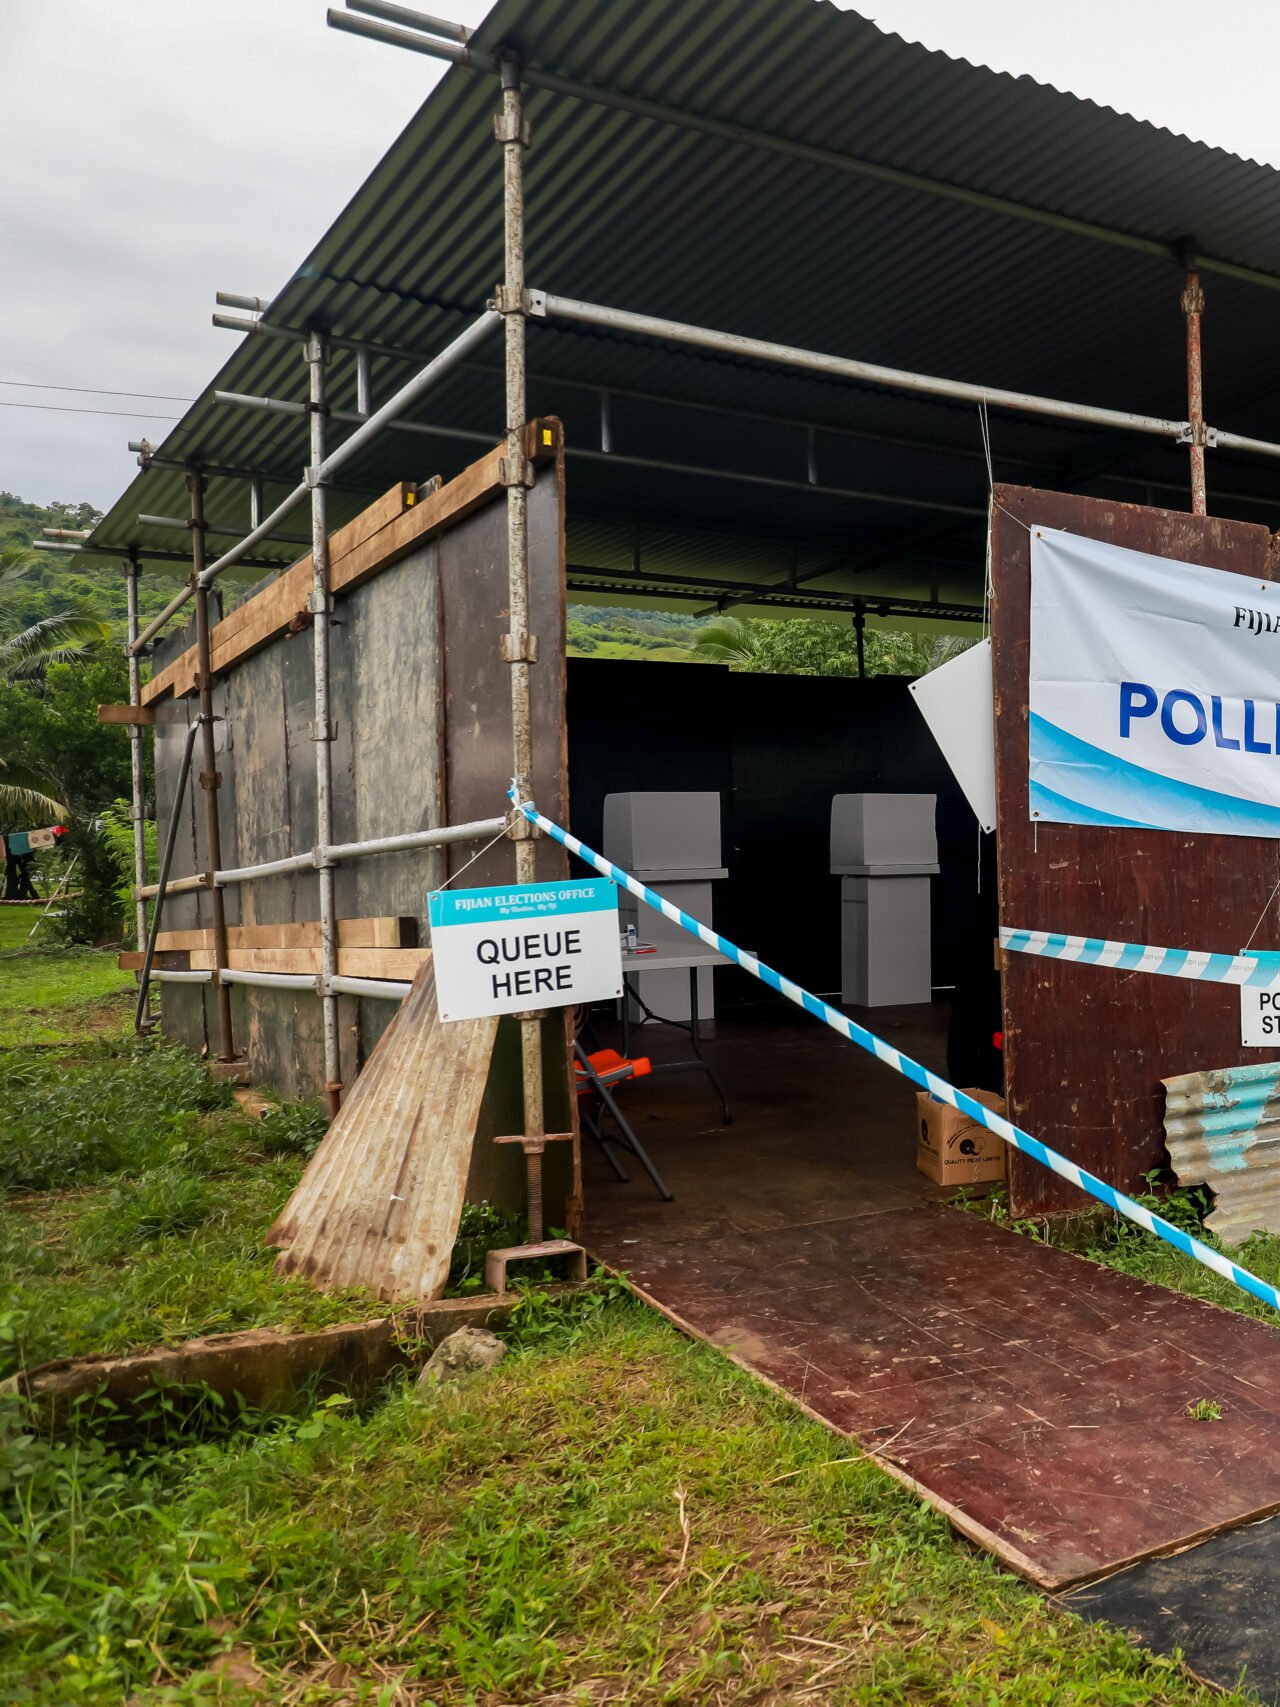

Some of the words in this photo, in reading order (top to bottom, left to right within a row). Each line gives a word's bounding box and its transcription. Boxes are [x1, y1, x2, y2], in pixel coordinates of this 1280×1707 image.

[455, 897, 492, 911] FIJIAN
[495, 891, 557, 907] ELECTIONS
[558, 888, 595, 900] OFFICE
[476, 930, 582, 965] QUEUE
[492, 965, 573, 999] HERE
